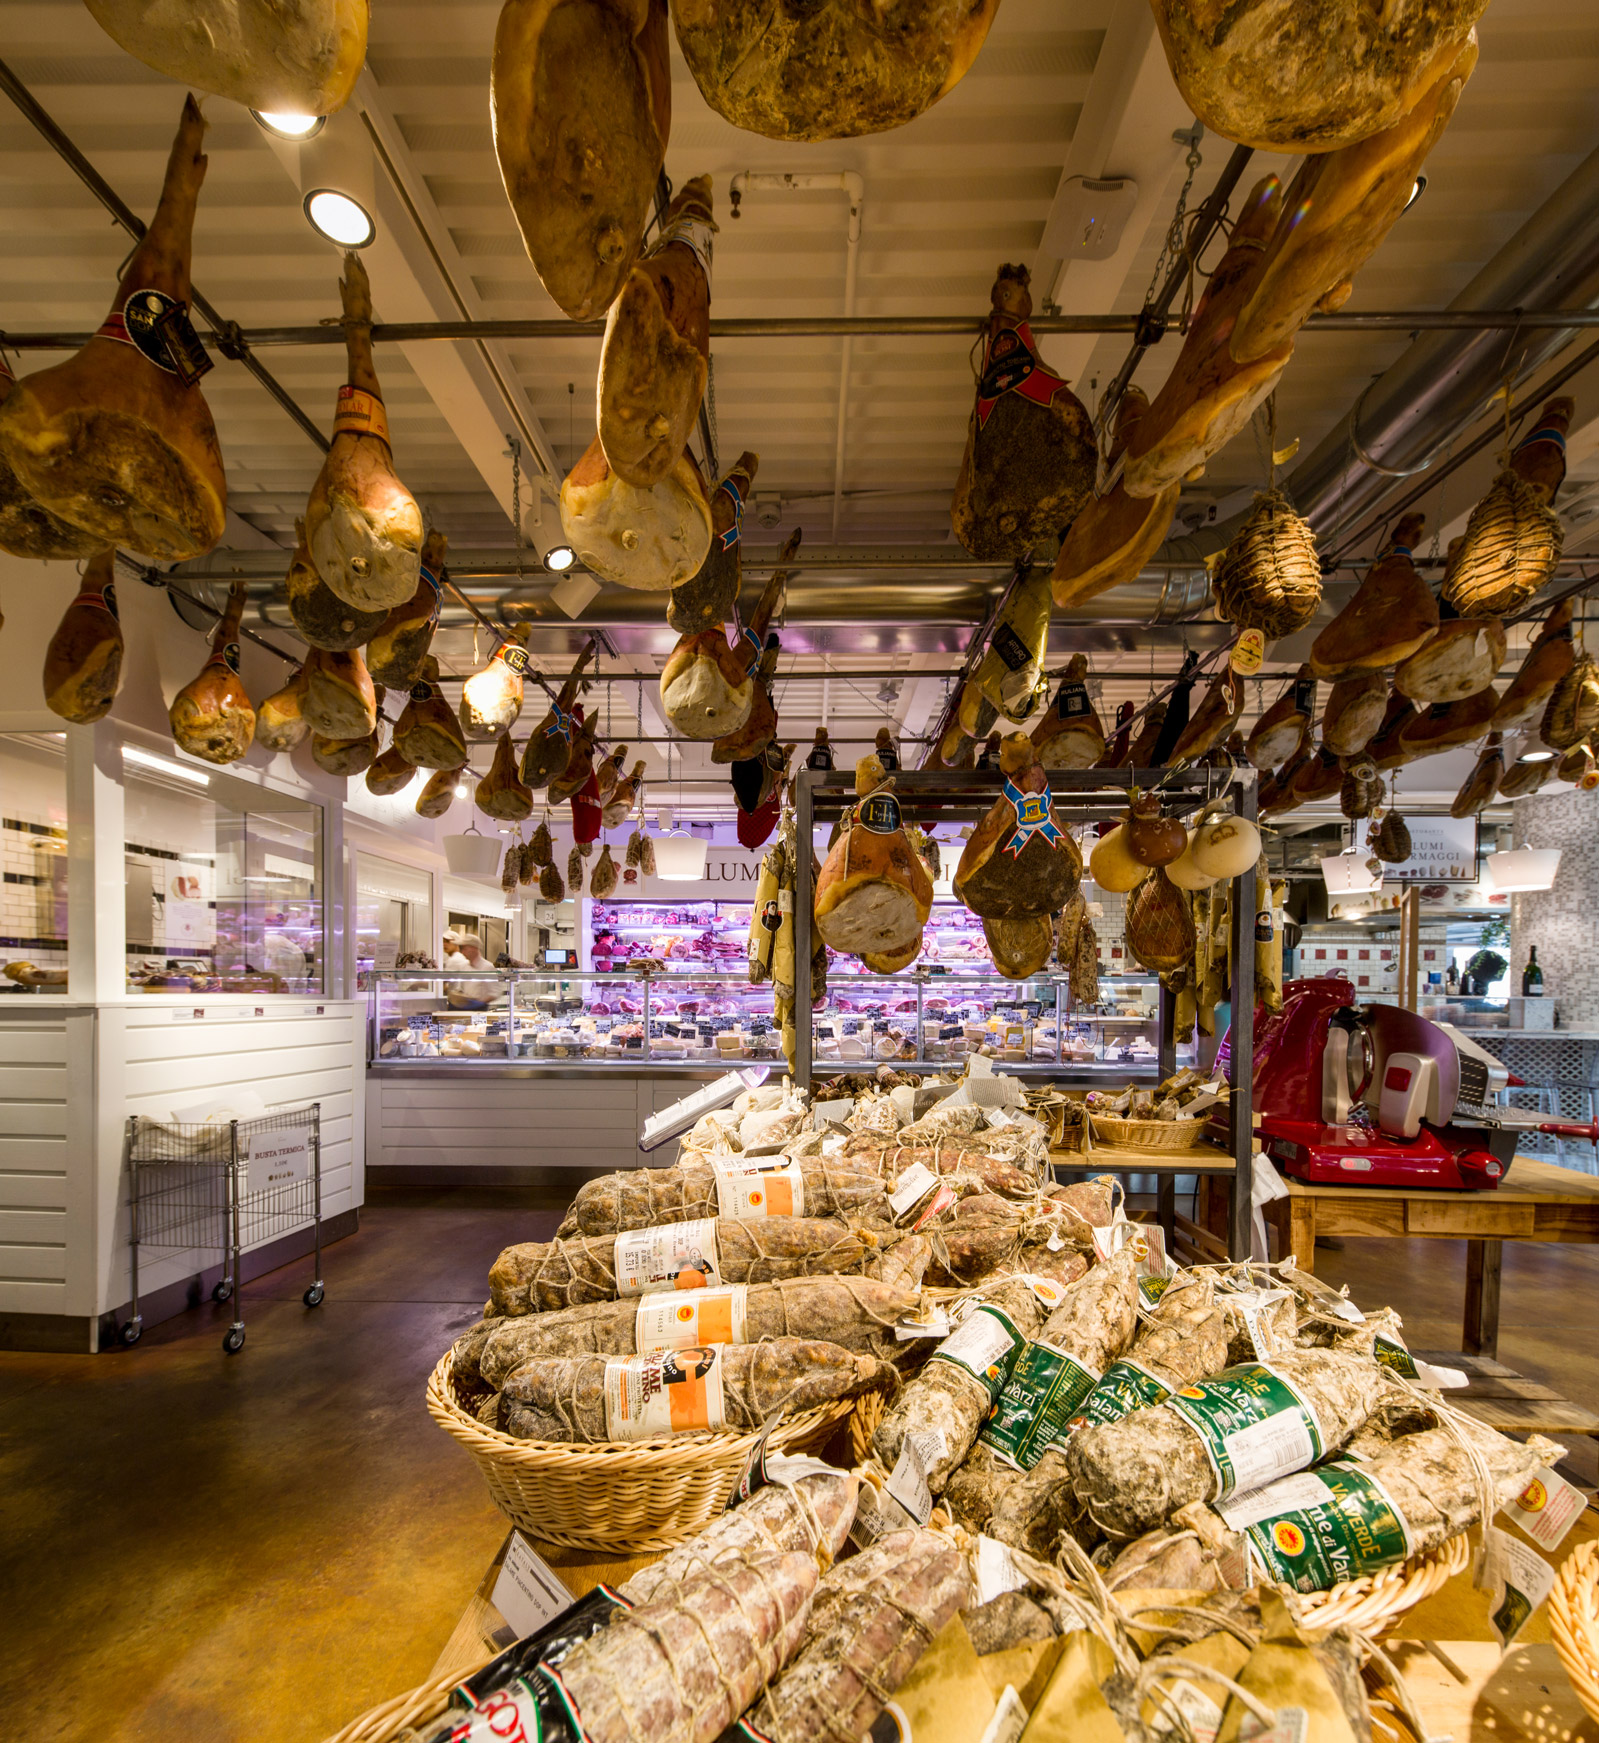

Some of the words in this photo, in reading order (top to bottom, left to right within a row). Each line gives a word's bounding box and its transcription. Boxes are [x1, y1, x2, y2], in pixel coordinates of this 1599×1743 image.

[1412, 842, 1444, 850] LUMI
[1410, 852, 1460, 861] RMAGGI
[255, 1150, 278, 1160] BUSTA
[278, 1145, 305, 1156] TERMICA
[1231, 1388, 1260, 1424] Varz
